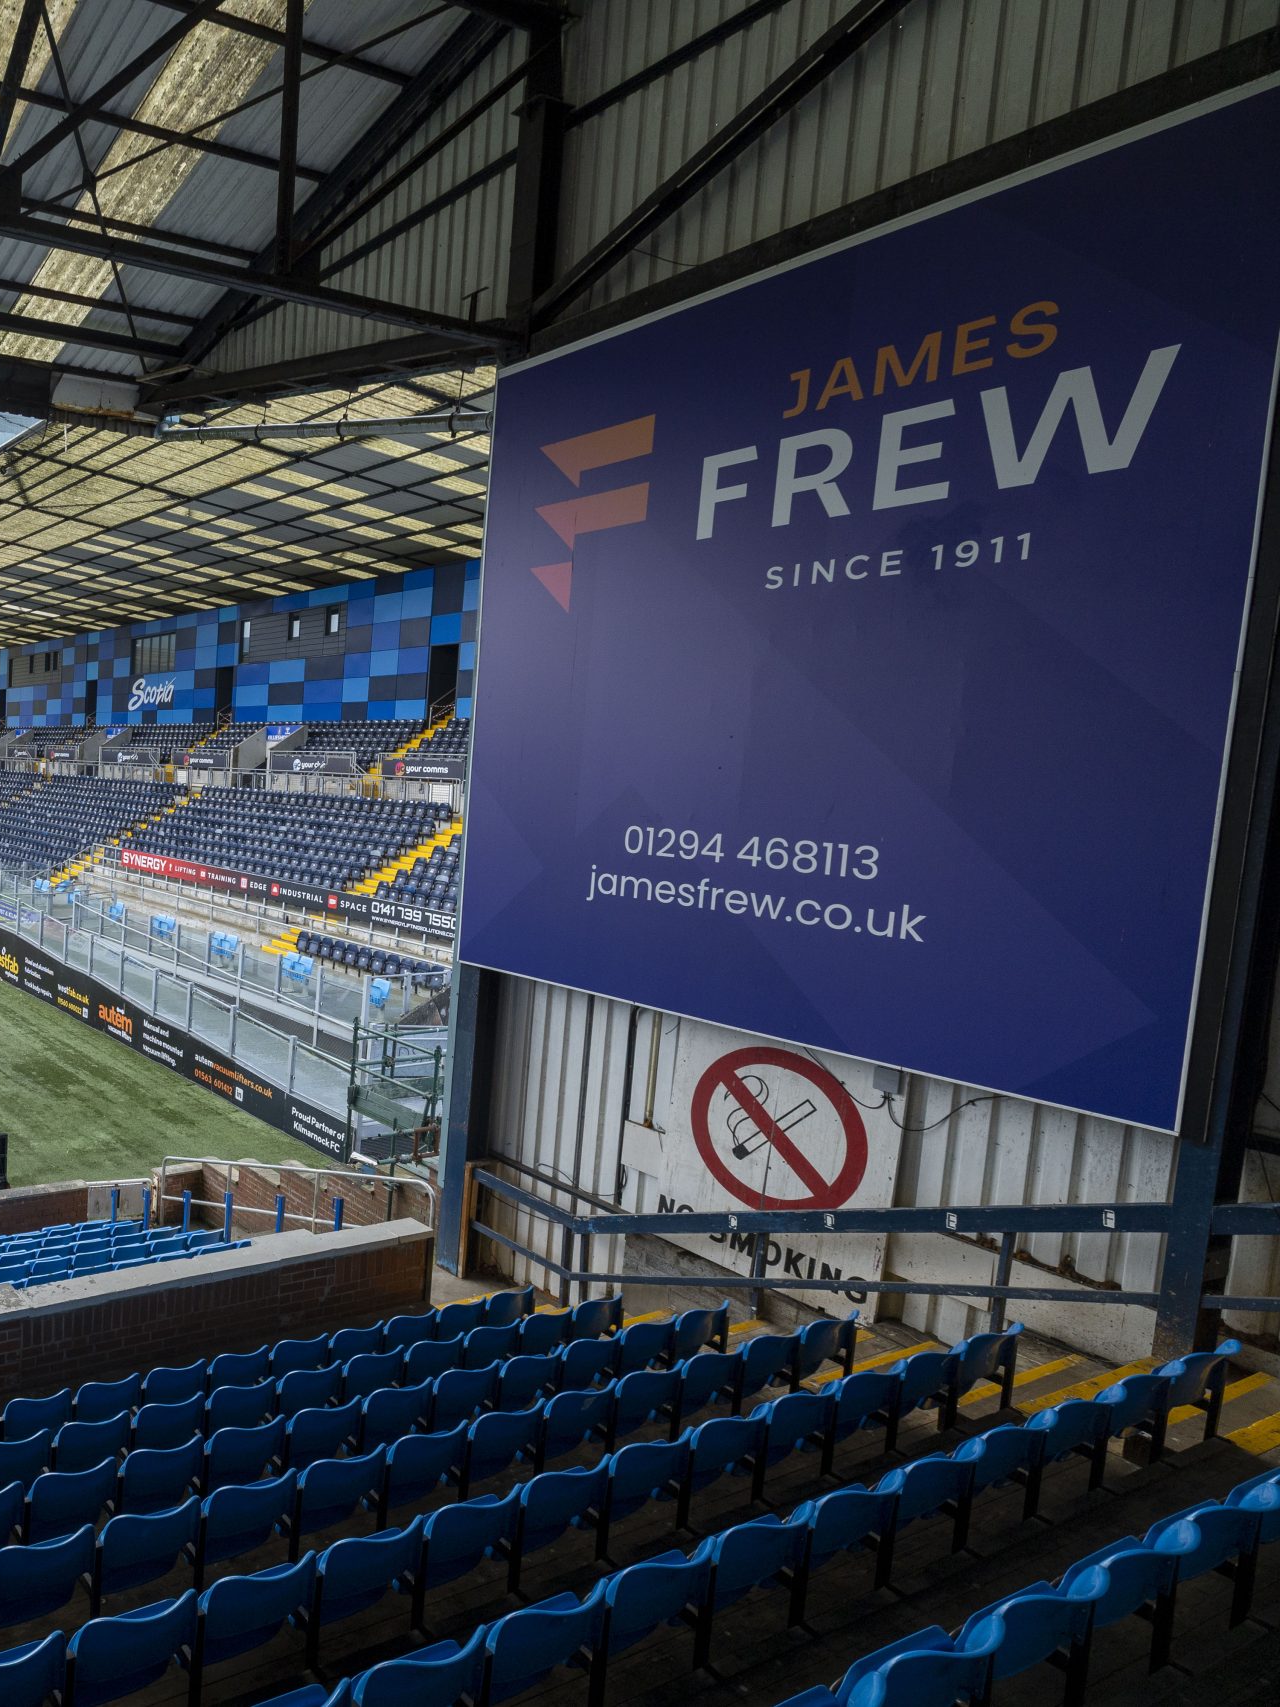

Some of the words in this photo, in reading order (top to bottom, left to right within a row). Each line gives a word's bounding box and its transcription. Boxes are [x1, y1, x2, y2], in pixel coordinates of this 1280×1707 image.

[782, 301, 1060, 419] JAMES
[696, 343, 1182, 541] FREW
[764, 549, 904, 590] SINCE
[931, 532, 1032, 571] 1911
[128, 677, 176, 711] Scotia
[406, 766, 421, 774] your
[423, 766, 448, 774] comms
[624, 825, 724, 863] 01294
[737, 836, 879, 880] 468113
[123, 852, 167, 871] SYNERGY
[175, 865, 196, 876] LIFTING
[208, 872, 236, 884] TRAINING
[249, 881, 267, 891] EDGE
[279, 887, 323, 903] INDUSTRIAL
[340, 900, 367, 913] SPACE
[371, 901, 395, 916] 0141
[397, 907, 421, 922] 739
[586, 864, 927, 942] jamesfrew.co.uk
[99, 1004, 133, 1036] autem
[143, 1019, 160, 1034] Manual
[160, 1029, 169, 1038] and
[143, 1032, 162, 1047] machine
[162, 1042, 183, 1057] mounted
[194, 1053, 273, 1099] autemvacuumlifters.co.uk
[291, 1106, 311, 1125] Proud
[311, 1118, 336, 1138] Partner
[336, 1132, 345, 1141] of
[293, 1120, 329, 1148] Kilmarnock
[330, 1141, 340, 1153] FC
